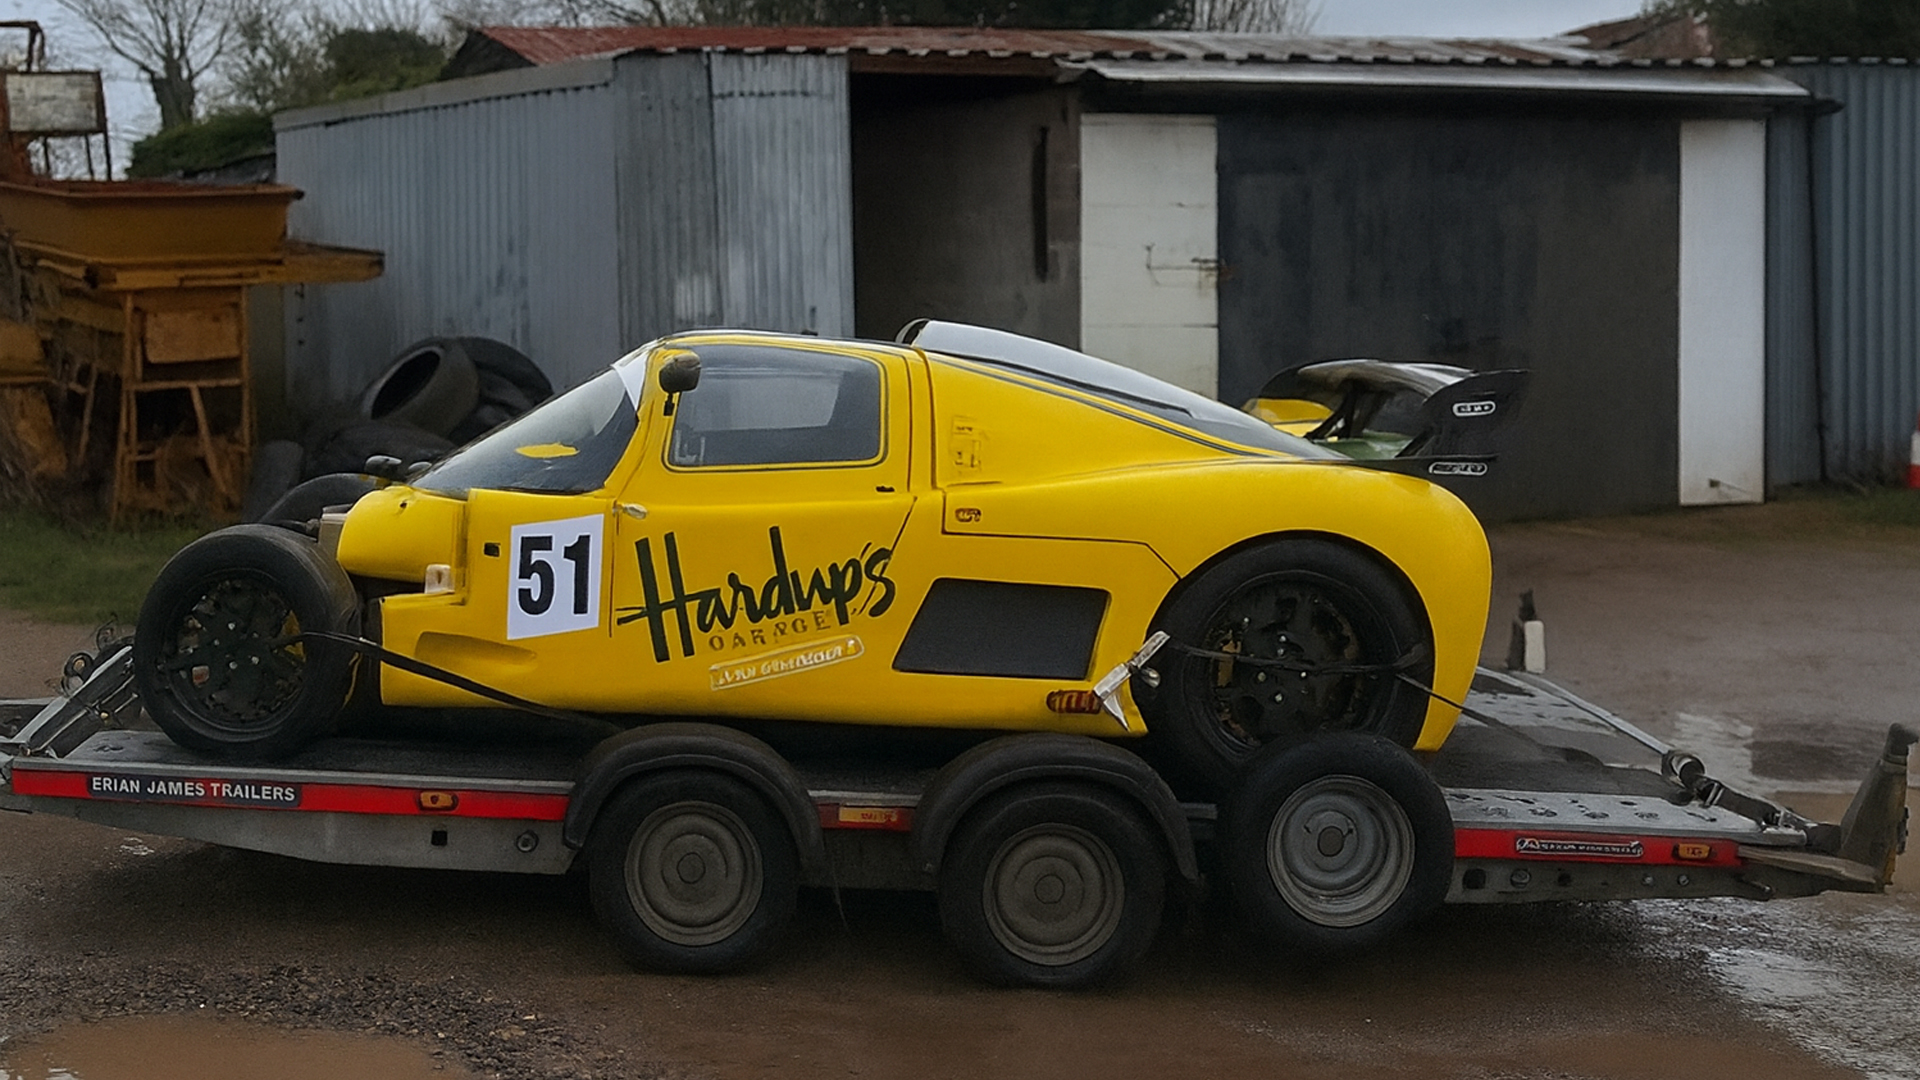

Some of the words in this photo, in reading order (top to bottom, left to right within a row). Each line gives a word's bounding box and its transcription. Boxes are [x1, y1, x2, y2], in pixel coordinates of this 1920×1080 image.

[516, 533, 592, 616] 51
[147, 780, 205, 797] JAMES
[211, 783, 295, 801] TRAILERS
